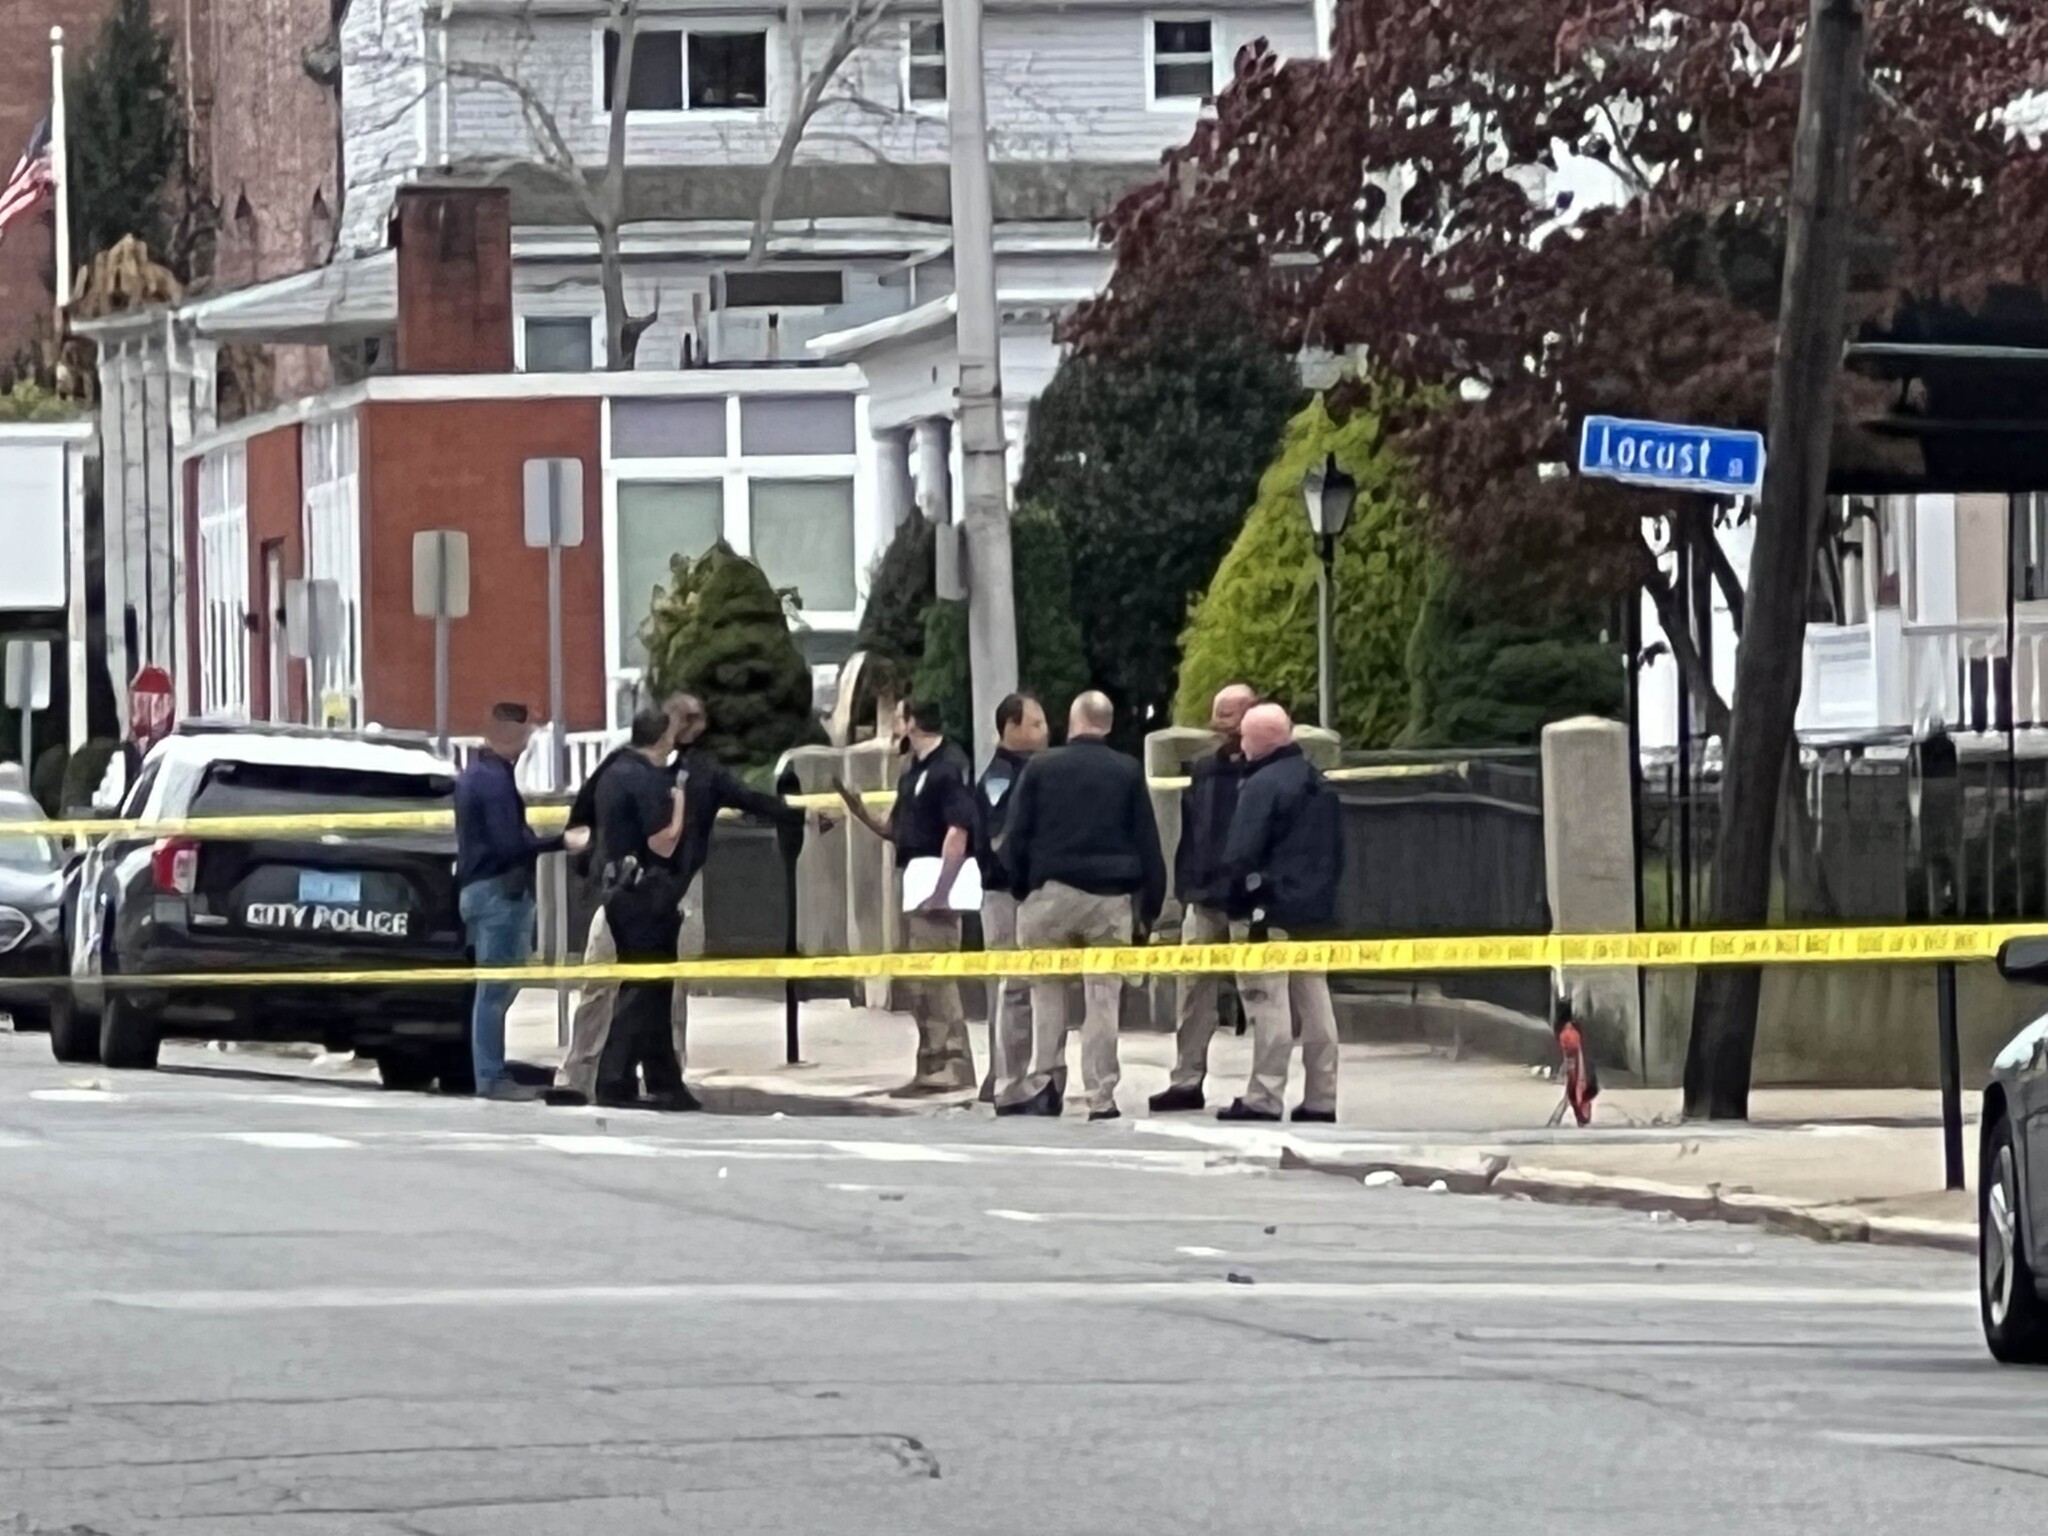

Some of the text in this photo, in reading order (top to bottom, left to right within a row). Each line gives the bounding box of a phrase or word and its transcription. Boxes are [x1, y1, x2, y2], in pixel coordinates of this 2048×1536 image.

[1600, 425, 1710, 478] Locust
[247, 903, 408, 936] CITY POLICE
